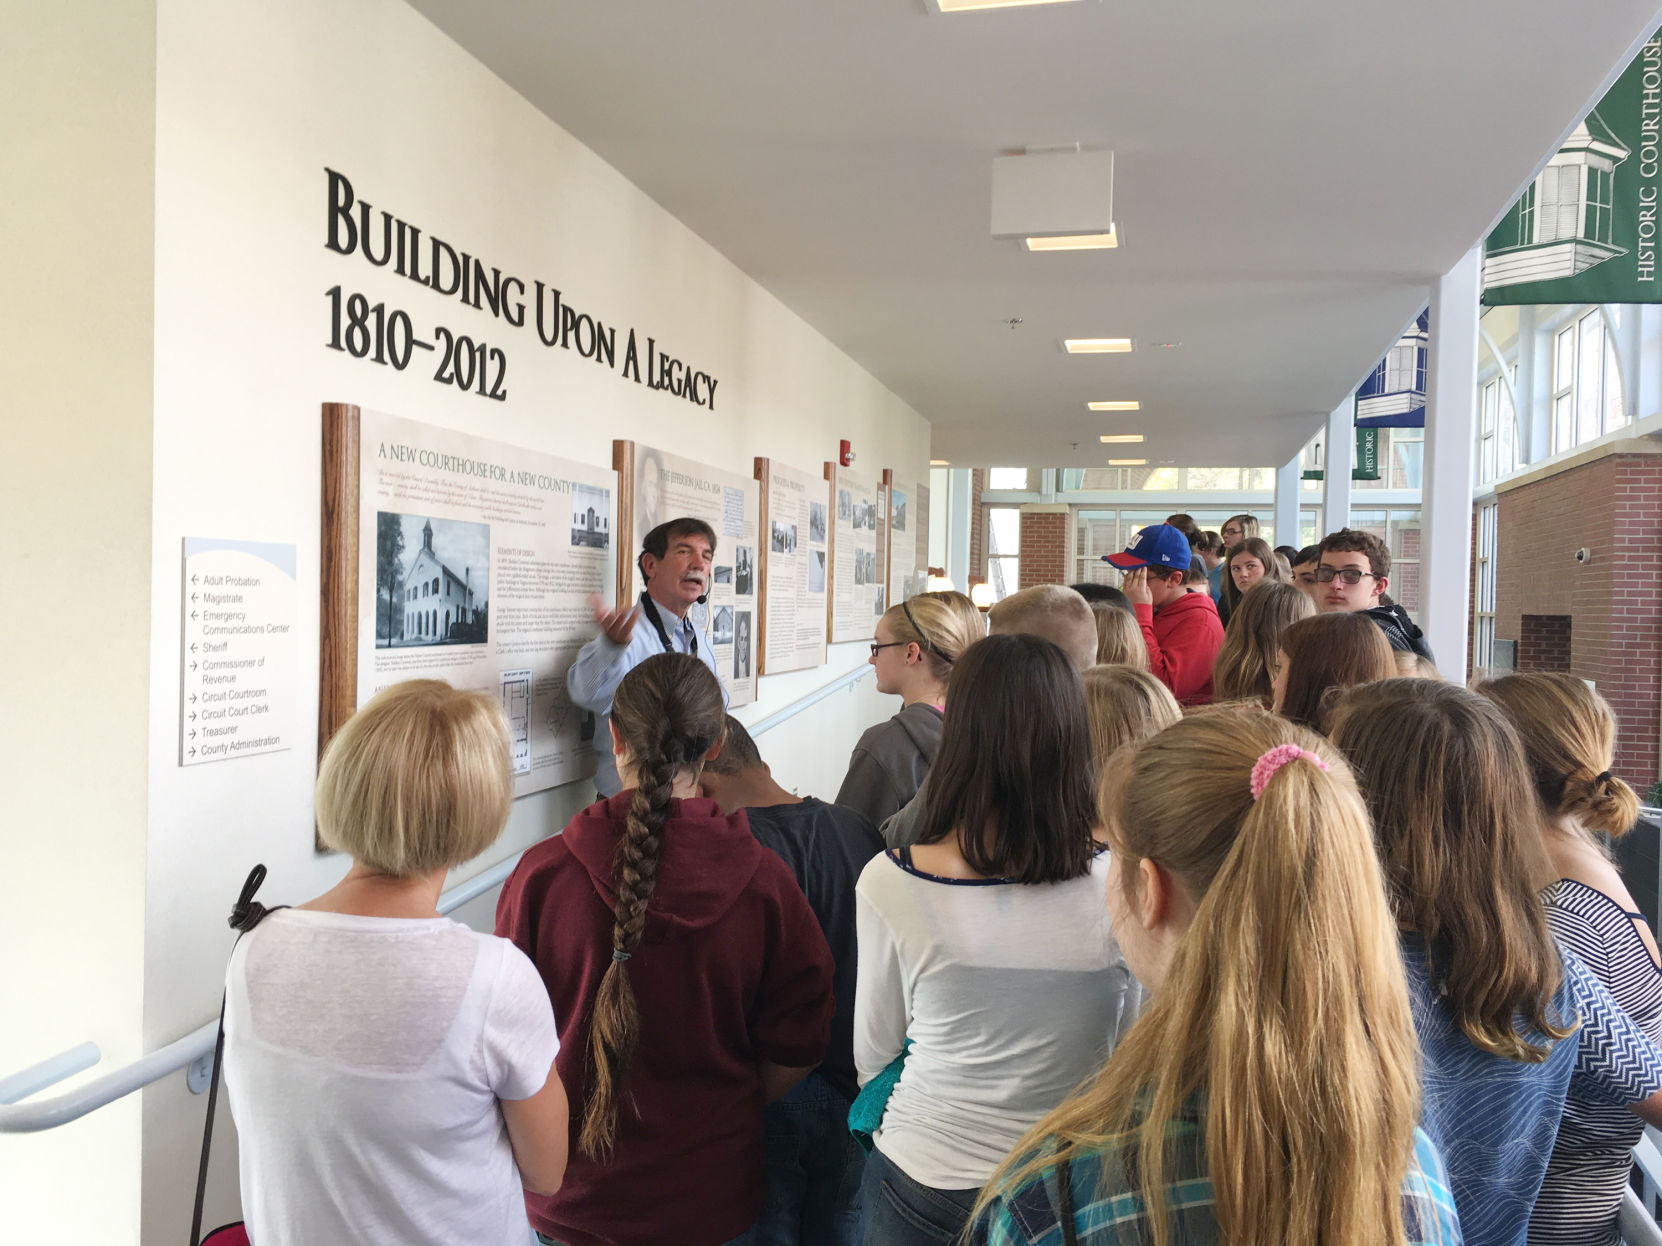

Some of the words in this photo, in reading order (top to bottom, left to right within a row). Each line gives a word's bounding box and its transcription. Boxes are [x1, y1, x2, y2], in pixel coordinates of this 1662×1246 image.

[1640, 36, 1662, 178] COURTHOUSE
[1637, 186, 1657, 283] HISTORIC
[324, 167, 525, 327] BUILDING
[534, 280, 616, 369] UPON
[622, 328, 642, 383] A
[647, 337, 719, 410] LEGACY
[1365, 431, 1374, 473] HISTORIC
[378, 441, 387, 459] A
[390, 443, 417, 464] NEW
[419, 448, 488, 479] COURTHOUSE
[489, 464, 507, 482] FOR
[509, 469, 515, 484] A
[517, 471, 536, 487] NEW
[537, 474, 571, 495] COUNTY
[203, 575, 224, 586] Adult
[225, 575, 261, 587] Probation
[203, 593, 243, 605] Magistrate
[203, 610, 246, 622] Emergency
[203, 624, 265, 635] Communications
[266, 623, 290, 633] Center
[203, 641, 228, 653] Sheriff
[202, 658, 256, 671] Commissioner
[257, 656, 265, 667] of
[202, 674, 237, 685] Revenue
[201, 691, 227, 703] Circuit
[228, 688, 267, 700] Courtroom
[201, 709, 226, 720] Circuit
[228, 706, 249, 717] Court
[250, 704, 269, 715] Clerk
[201, 725, 238, 737] Treasurer
[201, 743, 228, 755] County
[229, 735, 280, 751] Administration
